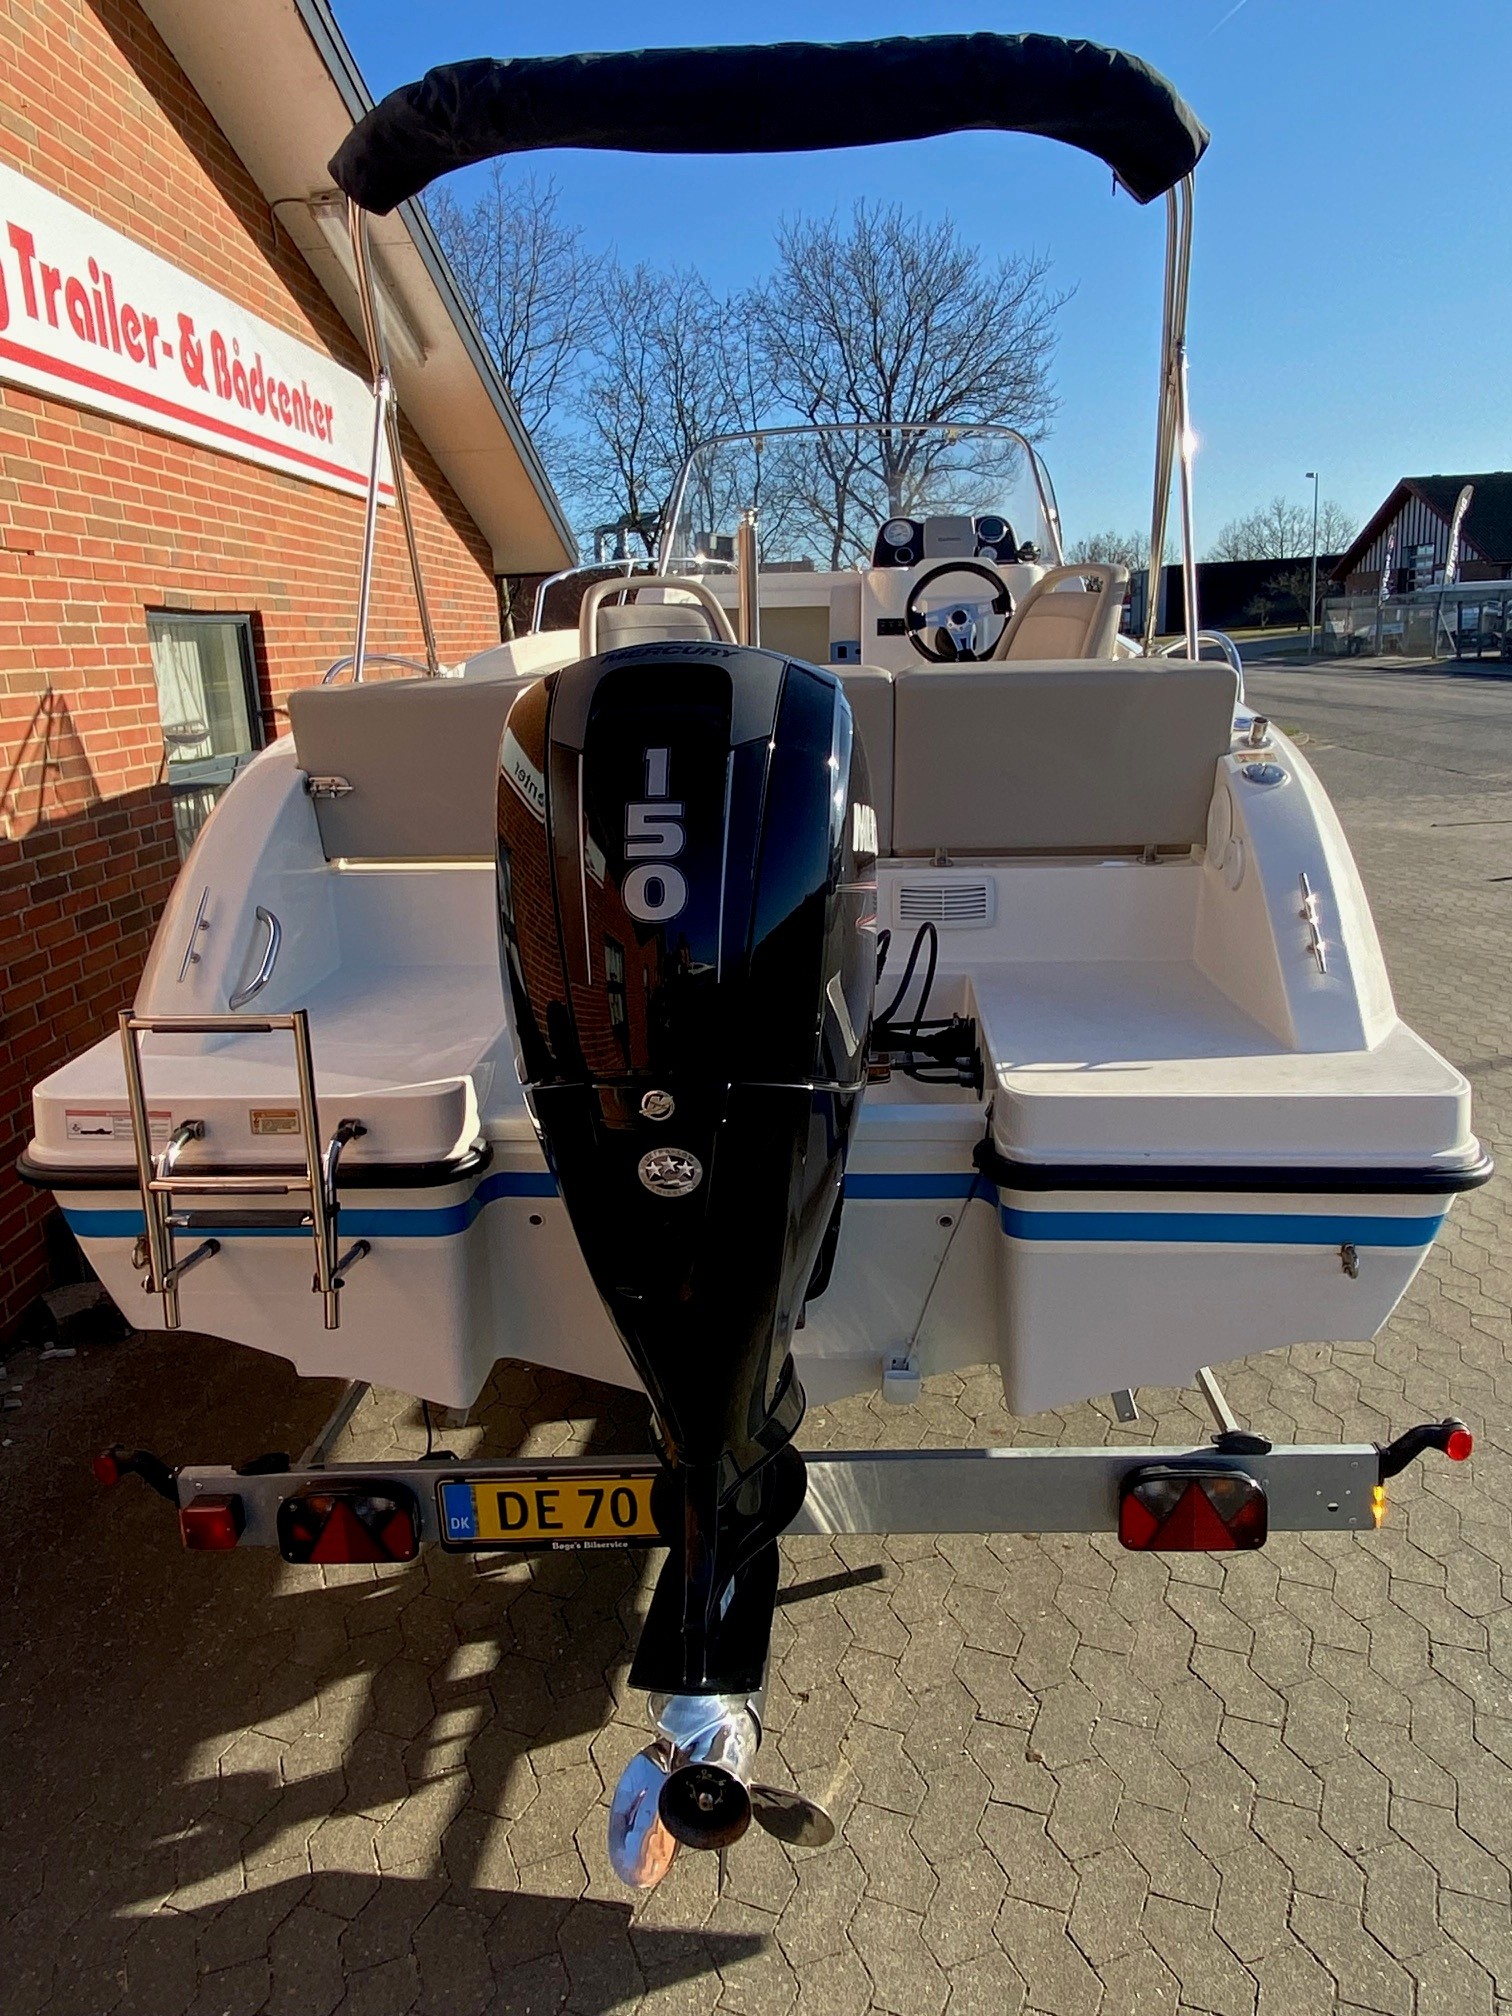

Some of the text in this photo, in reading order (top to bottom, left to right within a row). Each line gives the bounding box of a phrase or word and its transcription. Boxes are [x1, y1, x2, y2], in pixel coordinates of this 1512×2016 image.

[6, 220, 173, 370] Trailer-
[177, 312, 209, 393] &
[210, 329, 334, 445] Bådcenter
[600, 646, 739, 664] MERCURY
[623, 746, 688, 923] 150
[450, 1517, 470, 1530] DK
[496, 1487, 638, 1531] DE 70
[584, 1541, 629, 1549] Bilservice
